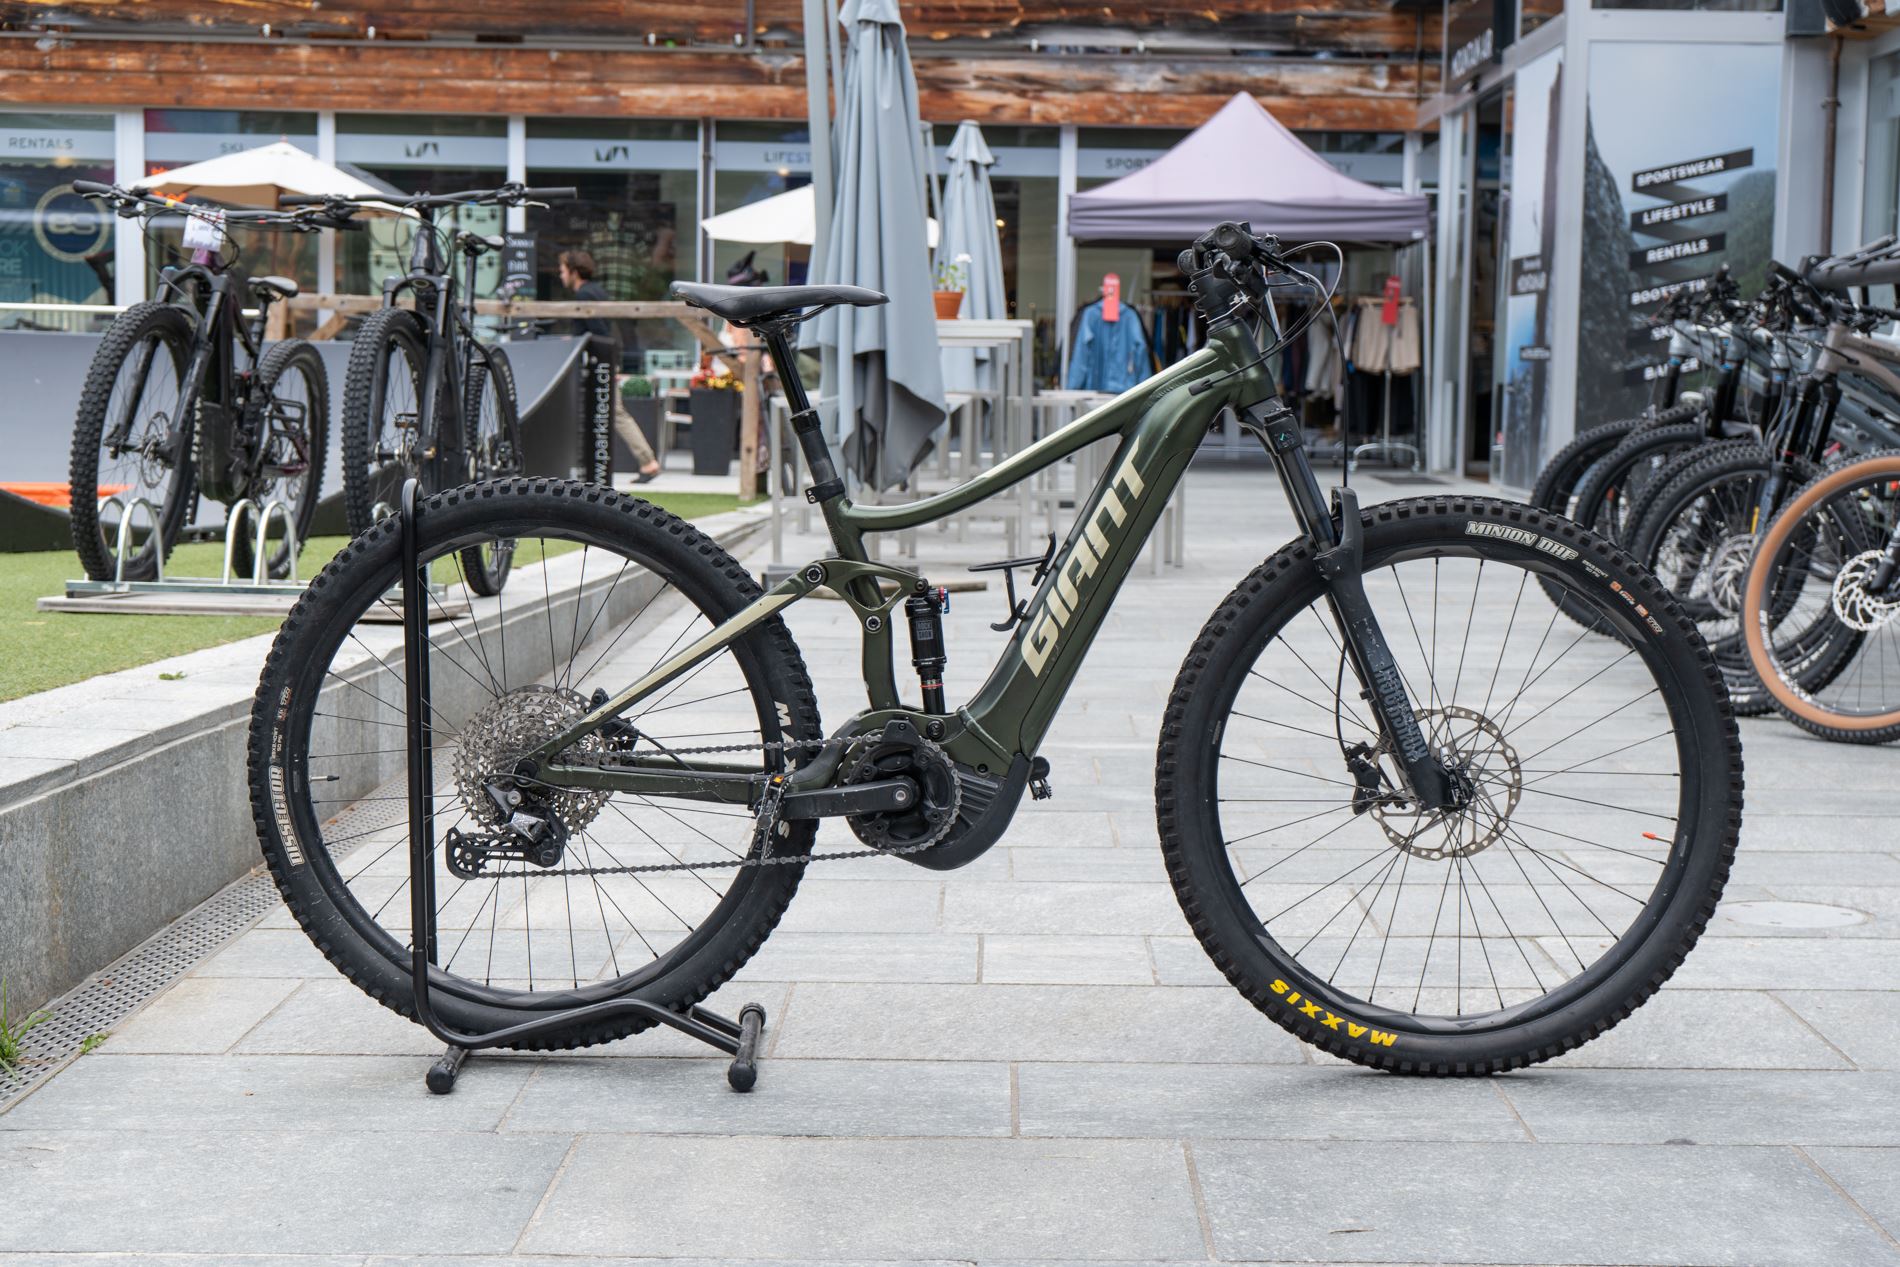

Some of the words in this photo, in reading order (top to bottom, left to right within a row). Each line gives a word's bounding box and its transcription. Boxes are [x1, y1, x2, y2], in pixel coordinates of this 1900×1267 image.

[8, 137, 74, 150] RENTALS
[763, 151, 811, 164] LIFEST
[1636, 157, 1725, 187] SPORTSWEAR
[1642, 198, 1717, 225] LIFESTYLE
[1646, 238, 1709, 264] RENTALS
[1465, 520, 1538, 547] MINION
[1535, 536, 1579, 561] DHF
[1021, 435, 1145, 678] GIANT
[269, 765, 305, 867] DISSECTOR
[1269, 978, 1399, 1047] MAXXIS
